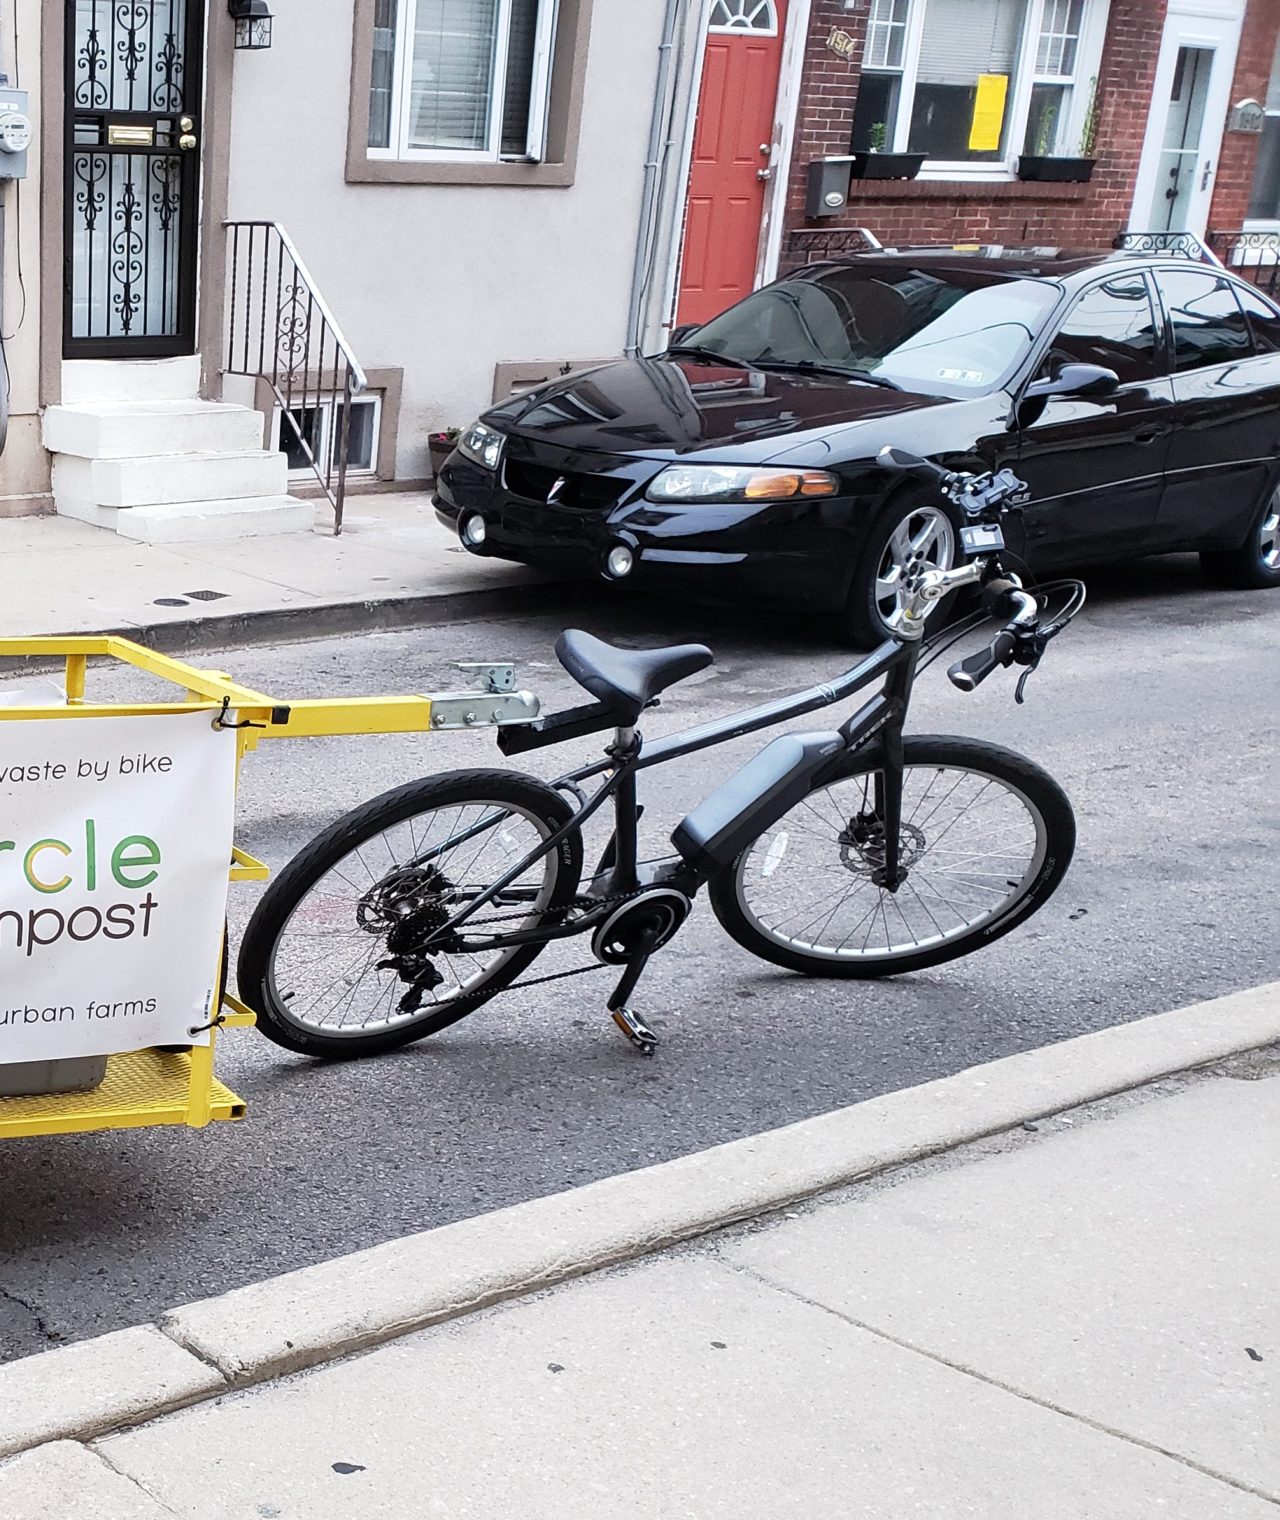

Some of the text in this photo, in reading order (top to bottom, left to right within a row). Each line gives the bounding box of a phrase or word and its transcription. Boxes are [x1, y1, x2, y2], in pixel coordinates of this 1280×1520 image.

[77, 758, 110, 782] by
[119, 753, 173, 774] bike
[86, 998, 157, 1020] farms
